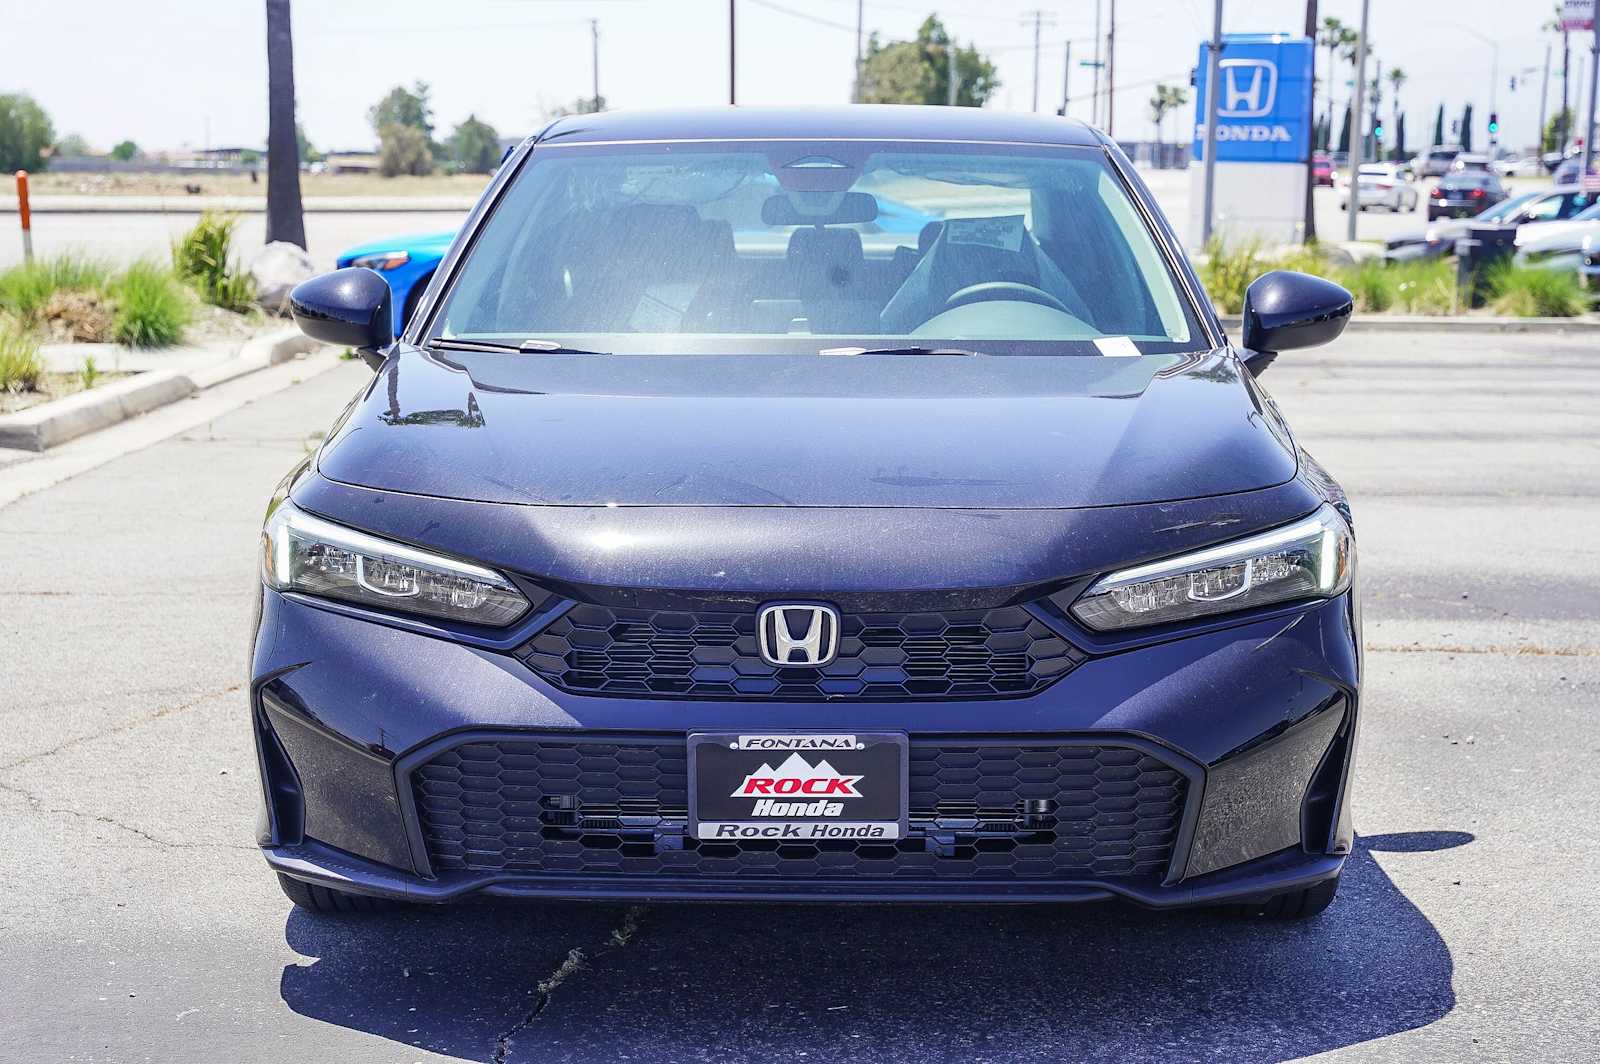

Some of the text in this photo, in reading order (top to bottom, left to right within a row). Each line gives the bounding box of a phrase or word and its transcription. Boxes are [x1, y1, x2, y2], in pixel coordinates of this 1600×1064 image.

[745, 738, 852, 748] FONTANA
[743, 778, 853, 794] ROCK
[751, 799, 845, 817] Honda
[715, 823, 885, 837] Rock Honda
